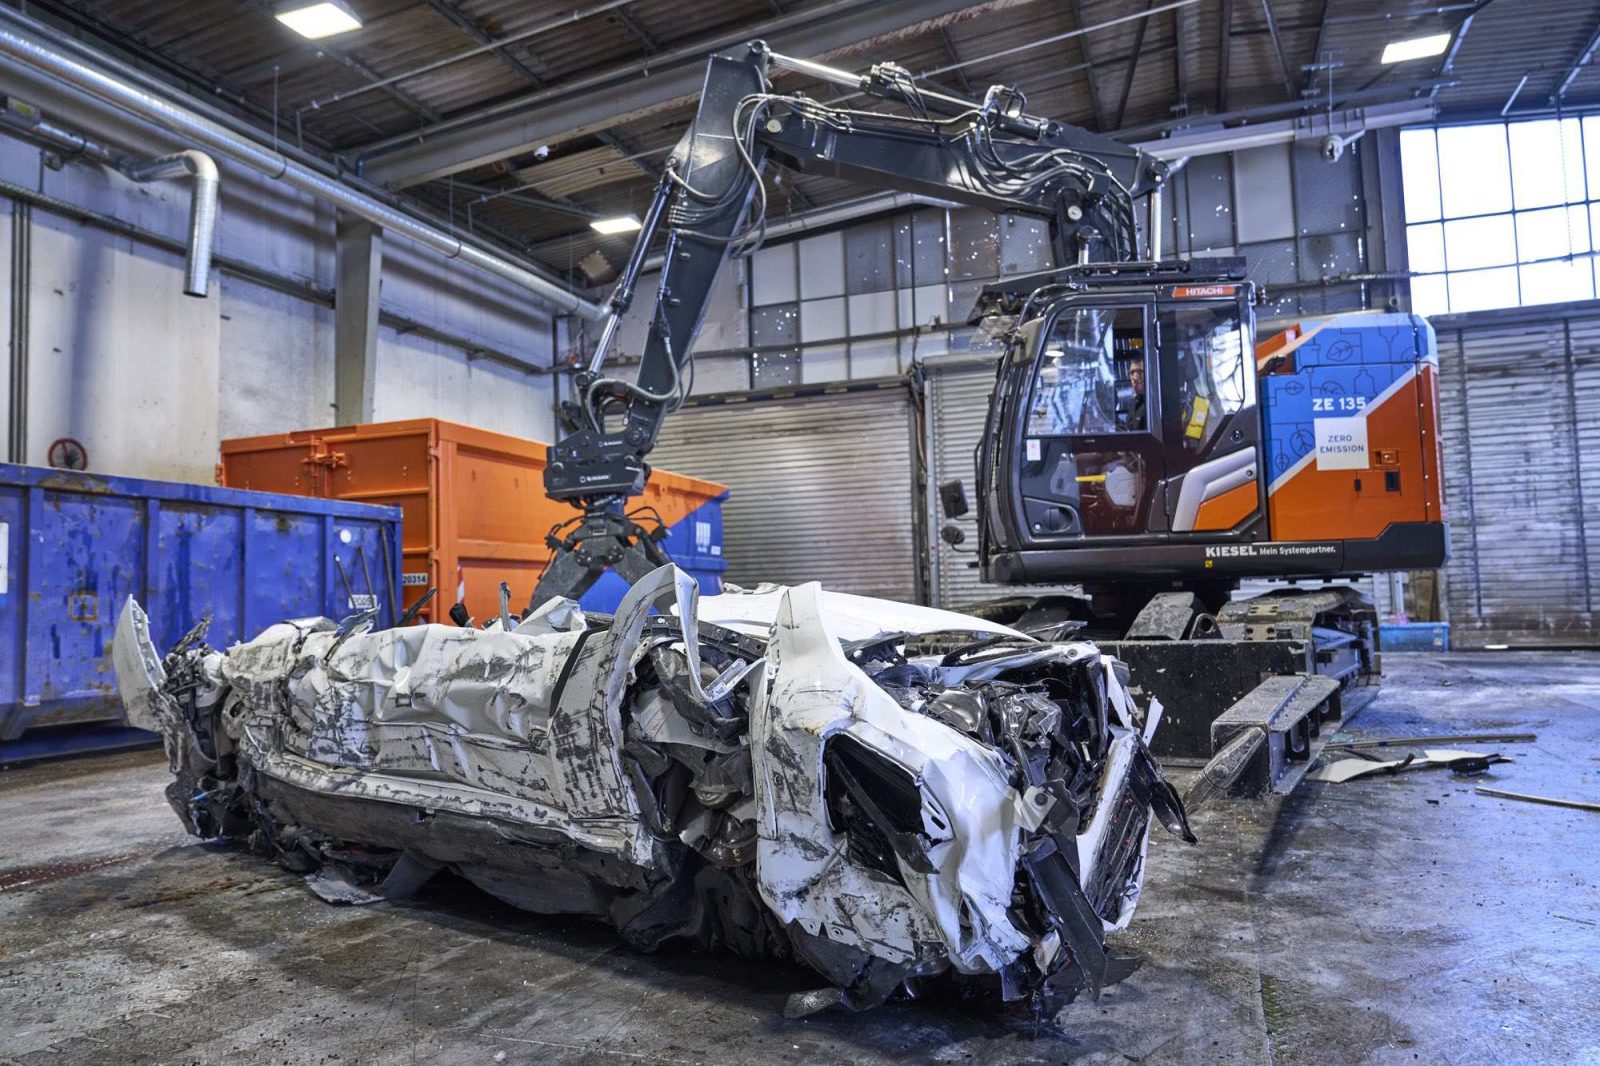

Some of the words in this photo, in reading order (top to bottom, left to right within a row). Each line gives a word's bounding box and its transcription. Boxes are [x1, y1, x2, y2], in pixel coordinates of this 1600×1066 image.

[1185, 287, 1223, 297] HITACHI
[1312, 397, 1335, 411] ZE
[1339, 396, 1366, 410] 135
[1327, 434, 1353, 443] ZERO
[1319, 444, 1364, 453] EMISSION
[1205, 545, 1257, 557] KIESEL
[1259, 546, 1278, 555] Mein
[1279, 545, 1336, 556] Systempartner.
[402, 574, 426, 584] 20314
